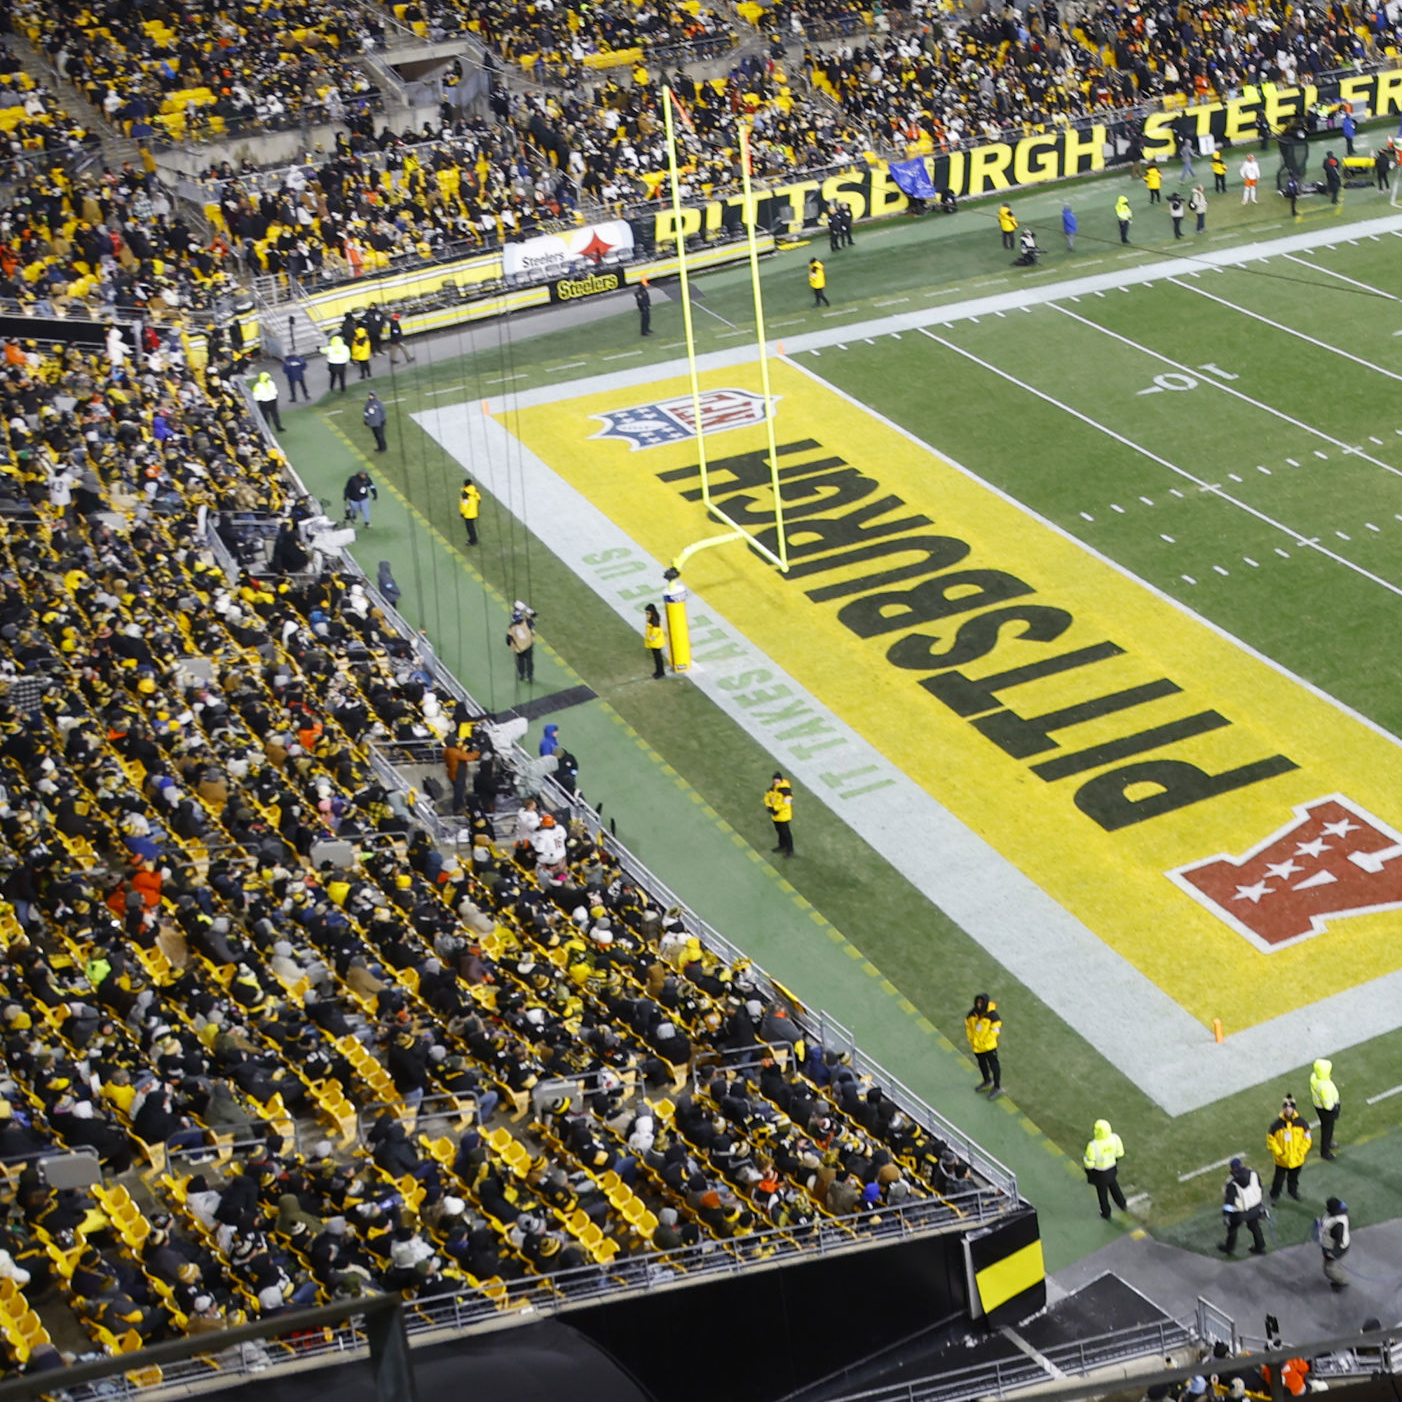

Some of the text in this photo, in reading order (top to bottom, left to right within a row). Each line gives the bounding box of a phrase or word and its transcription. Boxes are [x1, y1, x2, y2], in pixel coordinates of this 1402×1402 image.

[655, 123, 1106, 251] PITTSBURGH
[522, 250, 566, 270] Steelers
[557, 273, 619, 301] Steelers
[1152, 363, 1240, 391] 10
[580, 546, 648, 581] US
[654, 436, 1302, 833] PITTSBURGH
[716, 668, 849, 762] TAKES
[818, 763, 896, 800] IT
